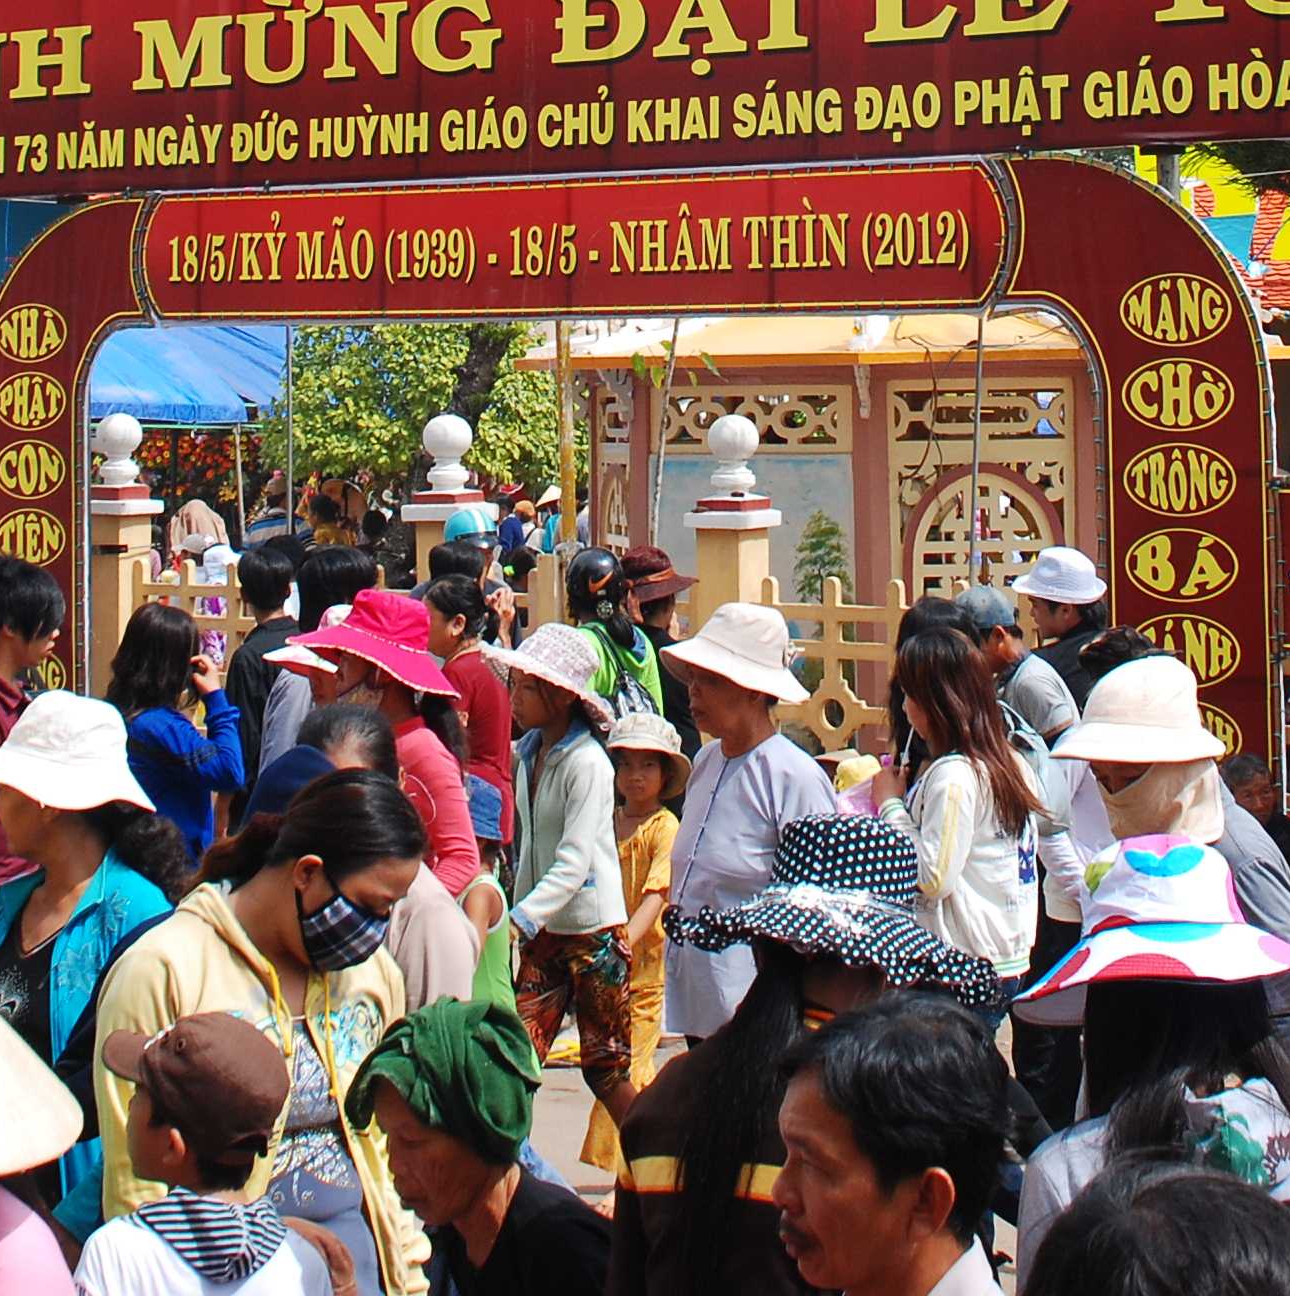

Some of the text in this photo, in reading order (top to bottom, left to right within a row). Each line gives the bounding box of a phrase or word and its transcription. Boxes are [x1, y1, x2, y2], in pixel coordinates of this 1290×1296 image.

[15, 134, 47, 172] 73
[57, 122, 124, 169] NĂM
[135, 124, 222, 166] NGÀY
[231, 111, 298, 161] ĐỨC
[309, 104, 428, 158] HUỲNH
[440, 96, 527, 152] GIÁO
[538, 86, 613, 147] CHỦ
[628, 96, 719, 142] KHAI
[733, 80, 842, 138] SÁNG
[855, 82, 940, 142] ĐẠO
[955, 66, 1068, 135] PHẬT
[1084, 55, 1192, 118] GIÁO
[170, 211, 286, 281] 18/5/KỶ
[296, 217, 373, 279] MÃO
[385, 229, 475, 281] (1939)
[511, 224, 576, 275] 18/5
[610, 203, 732, 272] NHÂM
[743, 198, 848, 268] THÌN
[862, 211, 968, 272] (2012)
[0, 307, 61, 358] NHÀ
[1127, 278, 1225, 342] MÃNG
[0, 376, 61, 426] PHẬT
[1130, 363, 1227, 427] CHỜ
[1131, 450, 1229, 512] TRÔNG
[1133, 535, 1230, 597] BÁ
